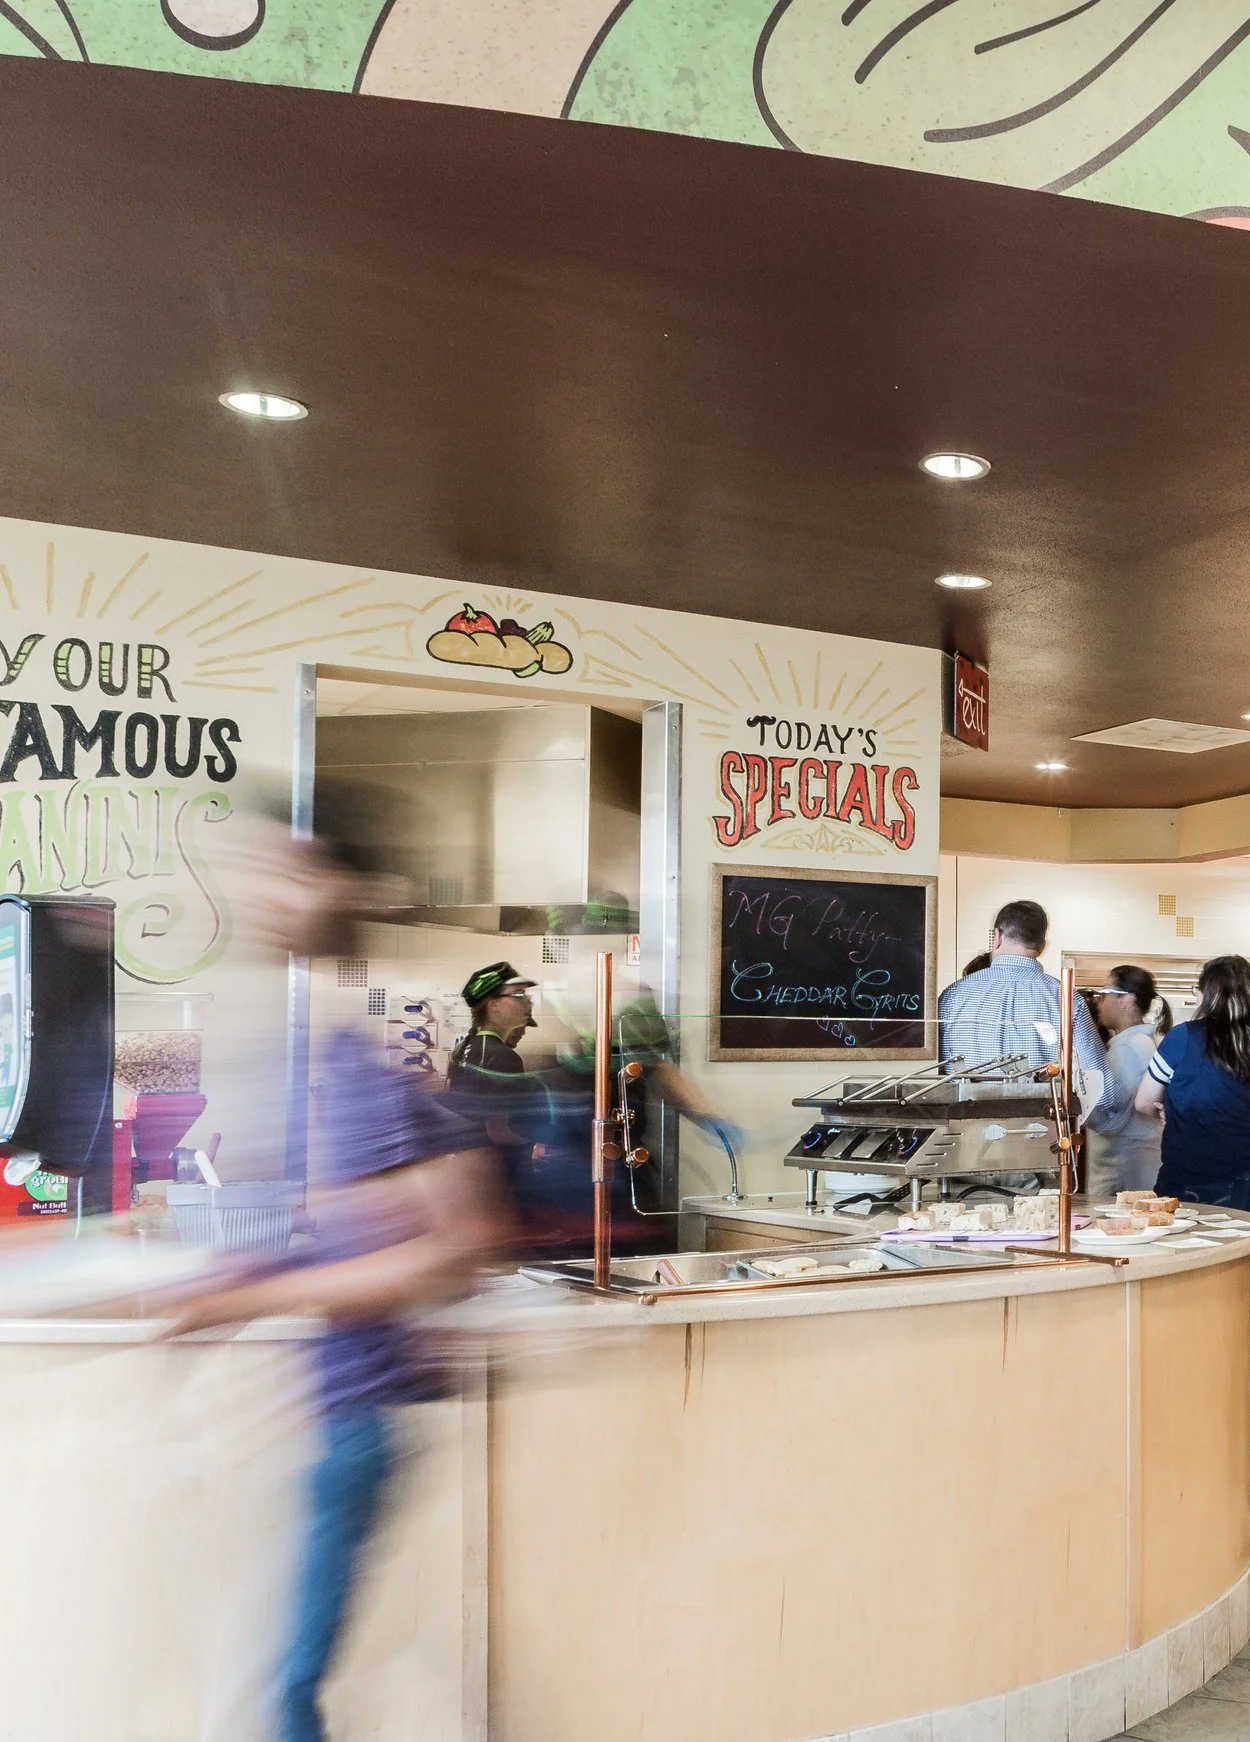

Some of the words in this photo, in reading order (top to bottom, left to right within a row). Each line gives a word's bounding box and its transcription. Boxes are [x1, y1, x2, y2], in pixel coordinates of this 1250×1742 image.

[0, 700, 243, 783] AMOUS
[746, 714, 878, 758] TODAY'S
[962, 685, 987, 736] exit
[712, 750, 920, 851] SPECIALS
